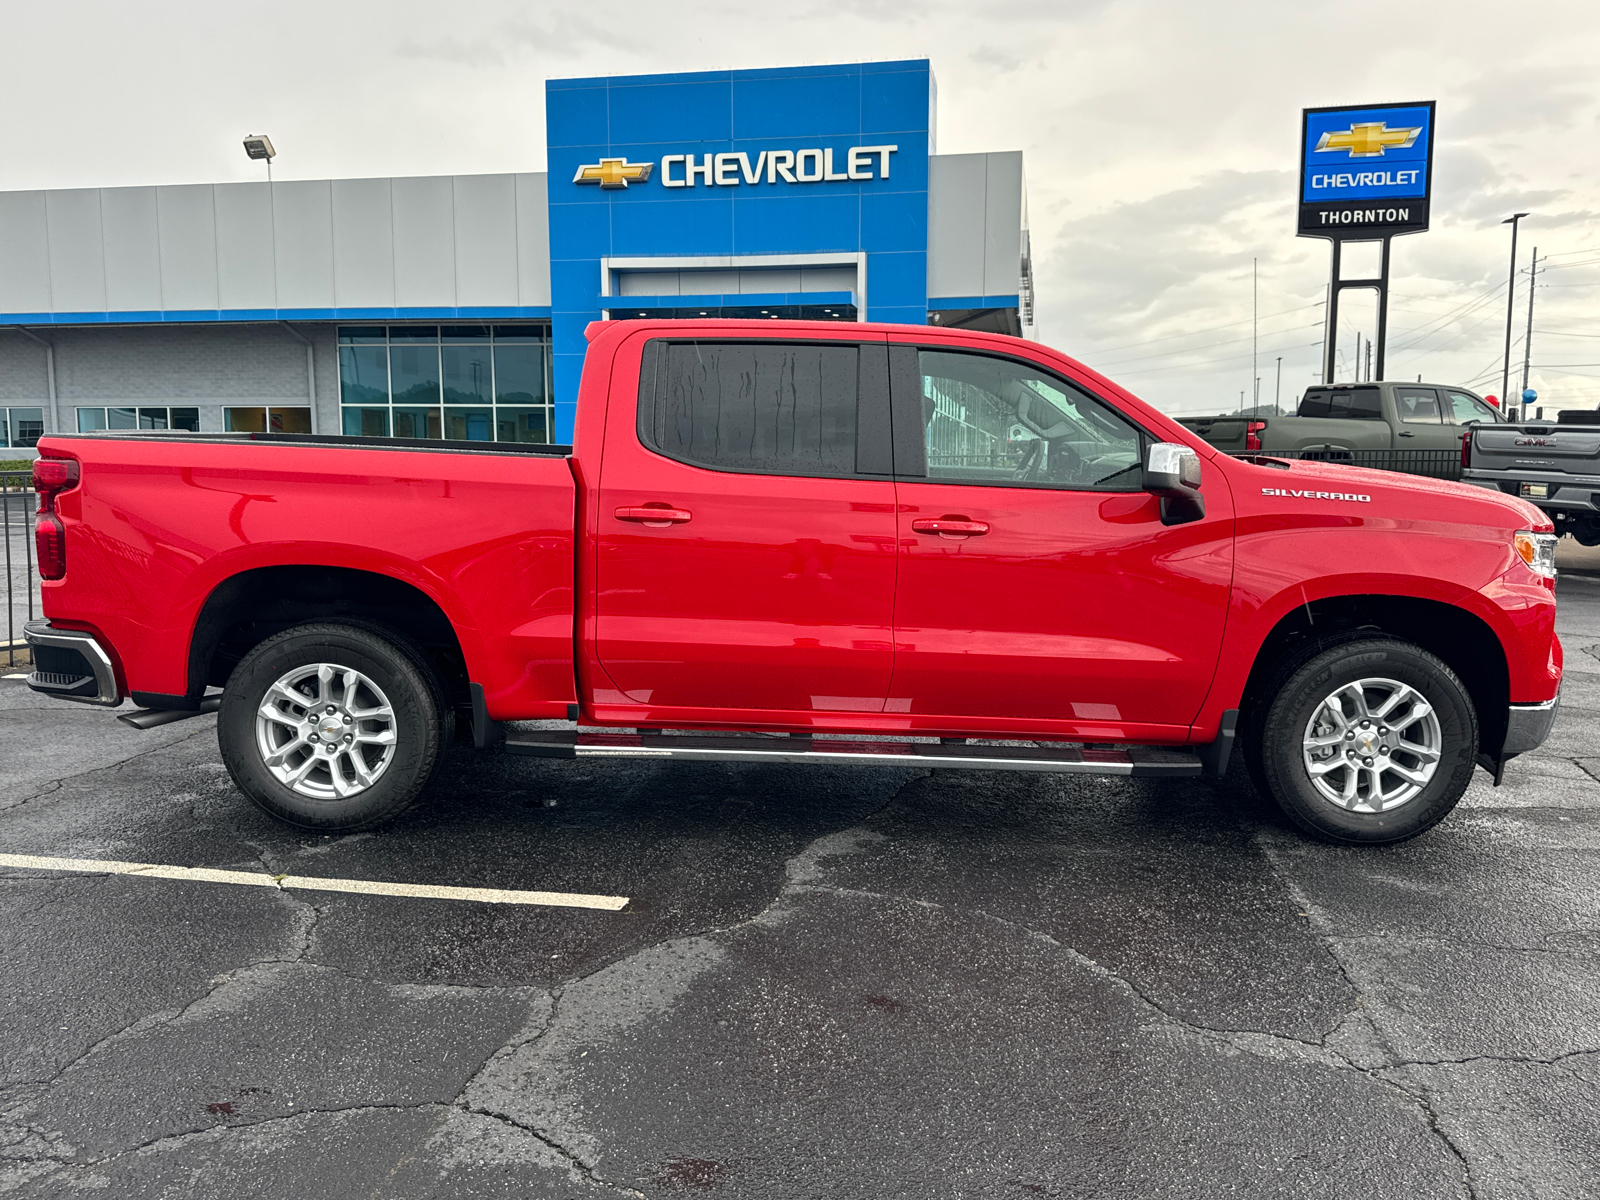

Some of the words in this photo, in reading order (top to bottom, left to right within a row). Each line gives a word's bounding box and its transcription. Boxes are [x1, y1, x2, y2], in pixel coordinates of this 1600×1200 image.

[660, 144, 898, 187] CHEVROLET
[1312, 170, 1420, 189] CHEVROLET
[1319, 208, 1409, 224] THORNTON
[1514, 436, 1557, 447] GMC
[1261, 487, 1371, 503] SILVERADO
